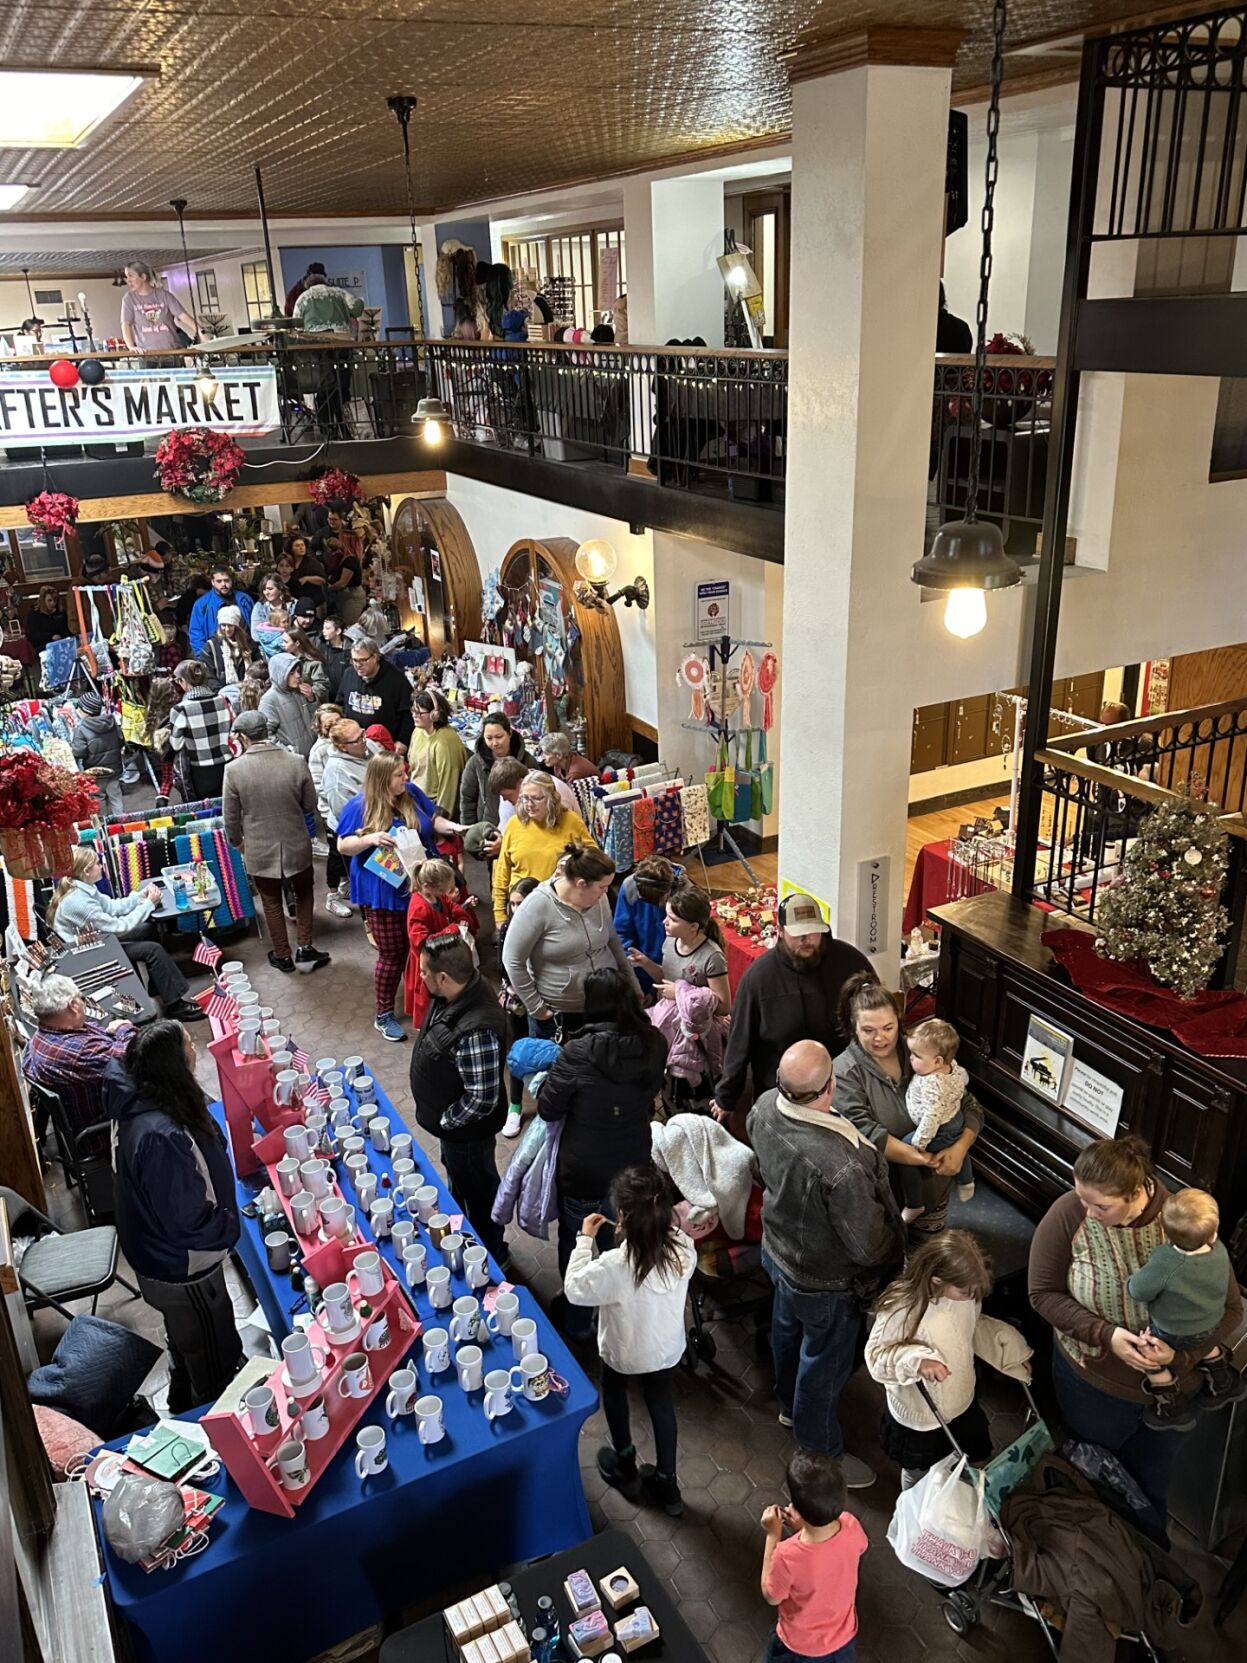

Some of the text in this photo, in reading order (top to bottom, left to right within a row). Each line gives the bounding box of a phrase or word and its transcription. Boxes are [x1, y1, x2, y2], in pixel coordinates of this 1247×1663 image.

[353, 276, 360, 286] P
[0, 382, 262, 430] FTER'S MARKET
[1084, 1080, 1093, 1089] DO
[1093, 1086, 1105, 1096] NOT
